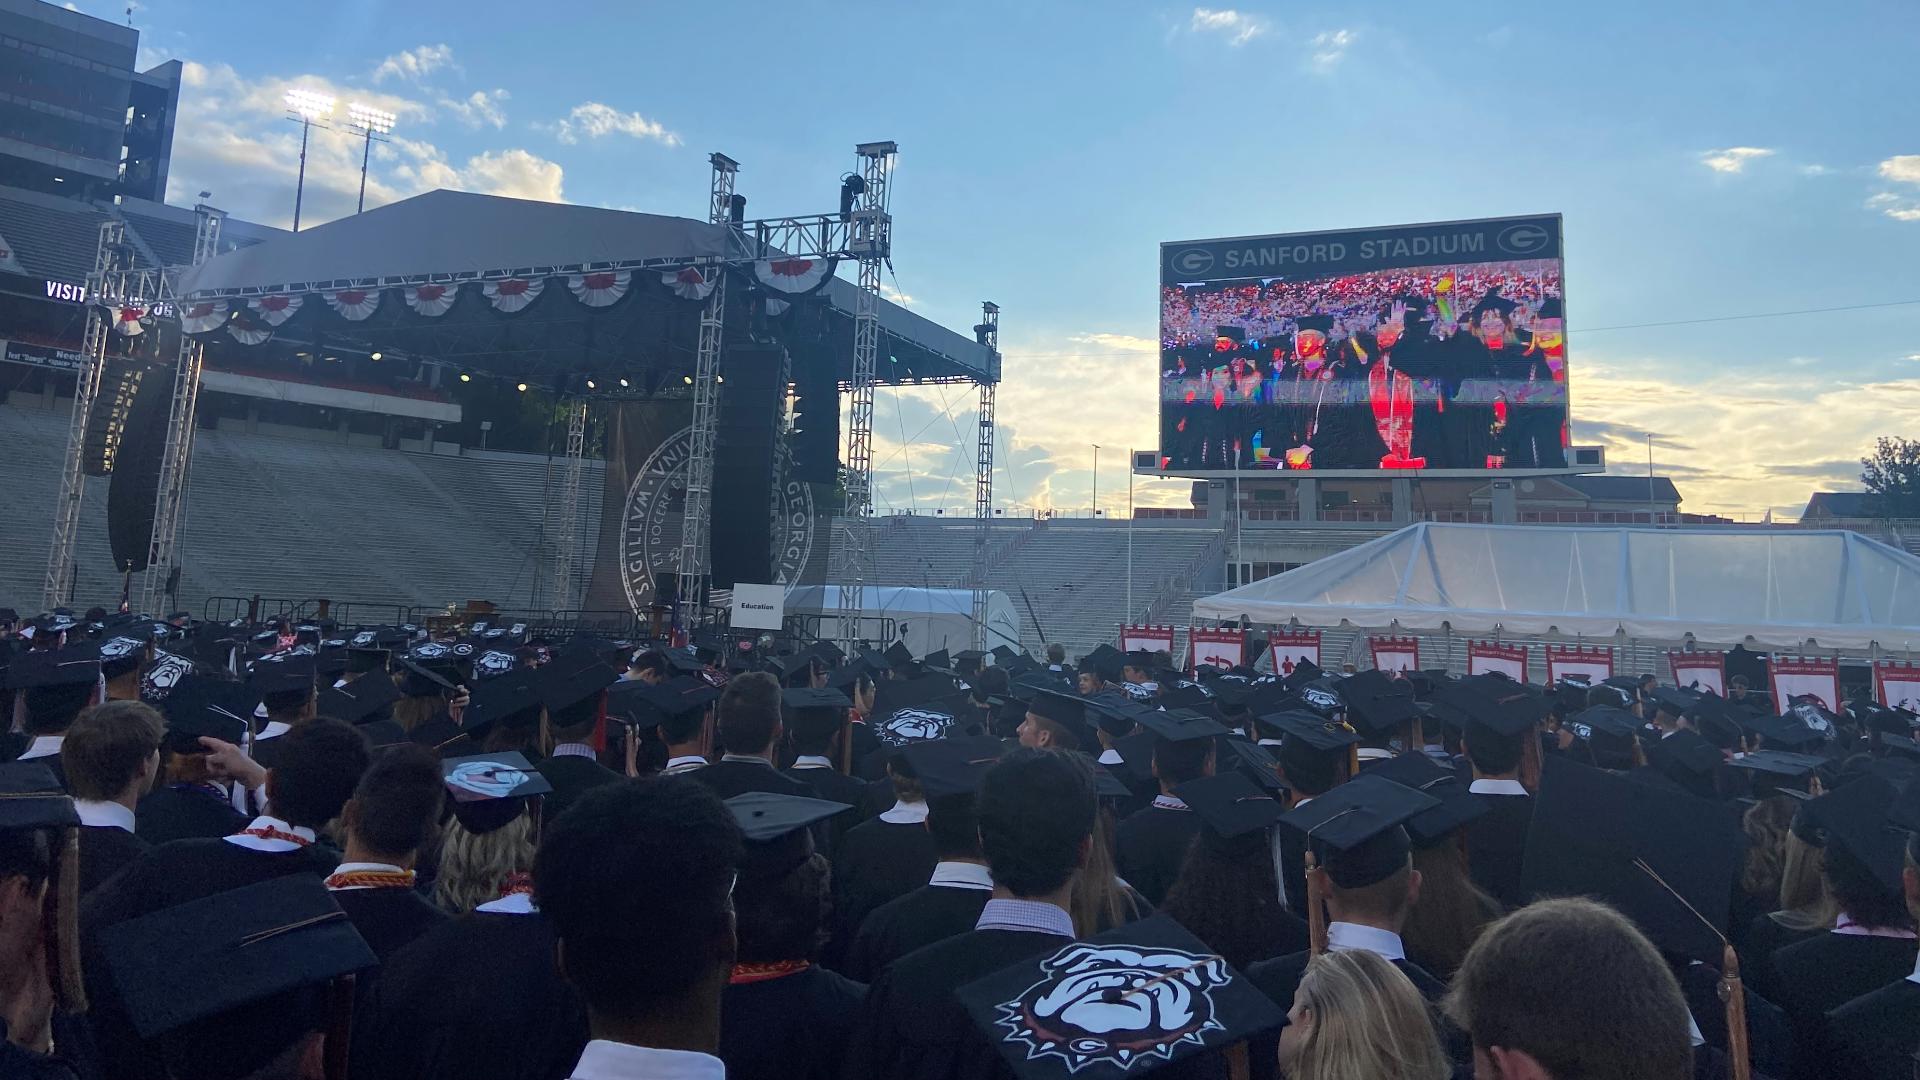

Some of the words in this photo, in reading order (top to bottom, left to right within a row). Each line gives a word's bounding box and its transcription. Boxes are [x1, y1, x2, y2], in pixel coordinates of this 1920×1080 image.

[1225, 243, 1346, 268] SANFORD
[1360, 232, 1485, 260] STADIUM
[46, 281, 85, 303] VISIT
[56, 350, 81, 361] Need
[629, 491, 652, 596] SIGILLVM
[776, 481, 806, 584] GEORGIA
[741, 602, 774, 610] Education
